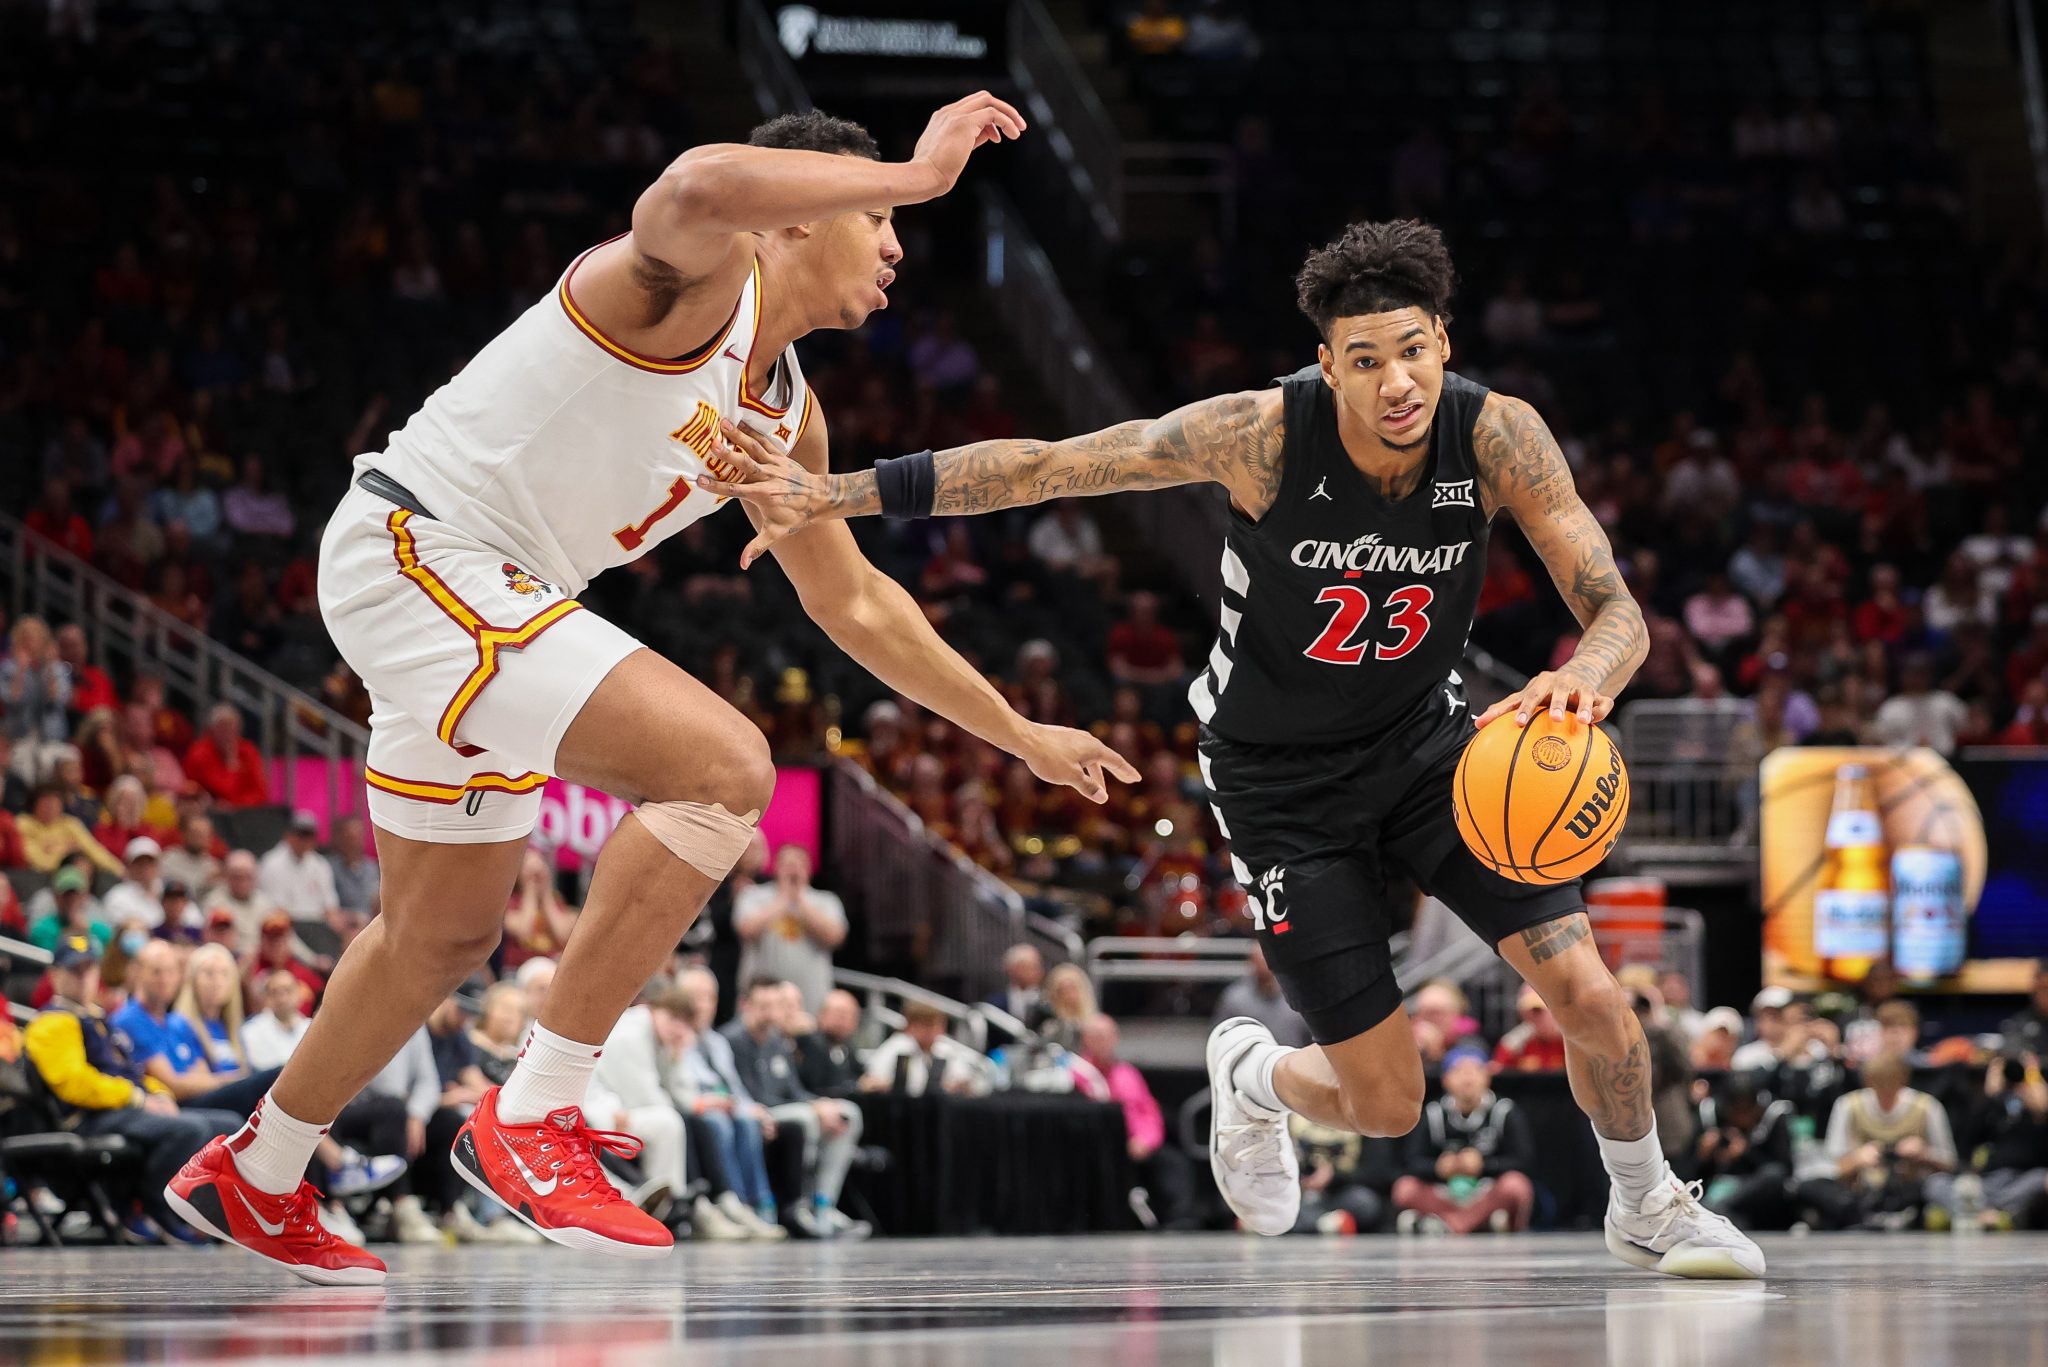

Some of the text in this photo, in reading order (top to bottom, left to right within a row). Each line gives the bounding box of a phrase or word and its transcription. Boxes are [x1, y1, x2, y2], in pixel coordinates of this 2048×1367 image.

[612, 475, 692, 552] 1
[1432, 479, 1475, 508] XII
[1290, 537, 1473, 575] CINCINNATI
[1302, 584, 1434, 665] 23
